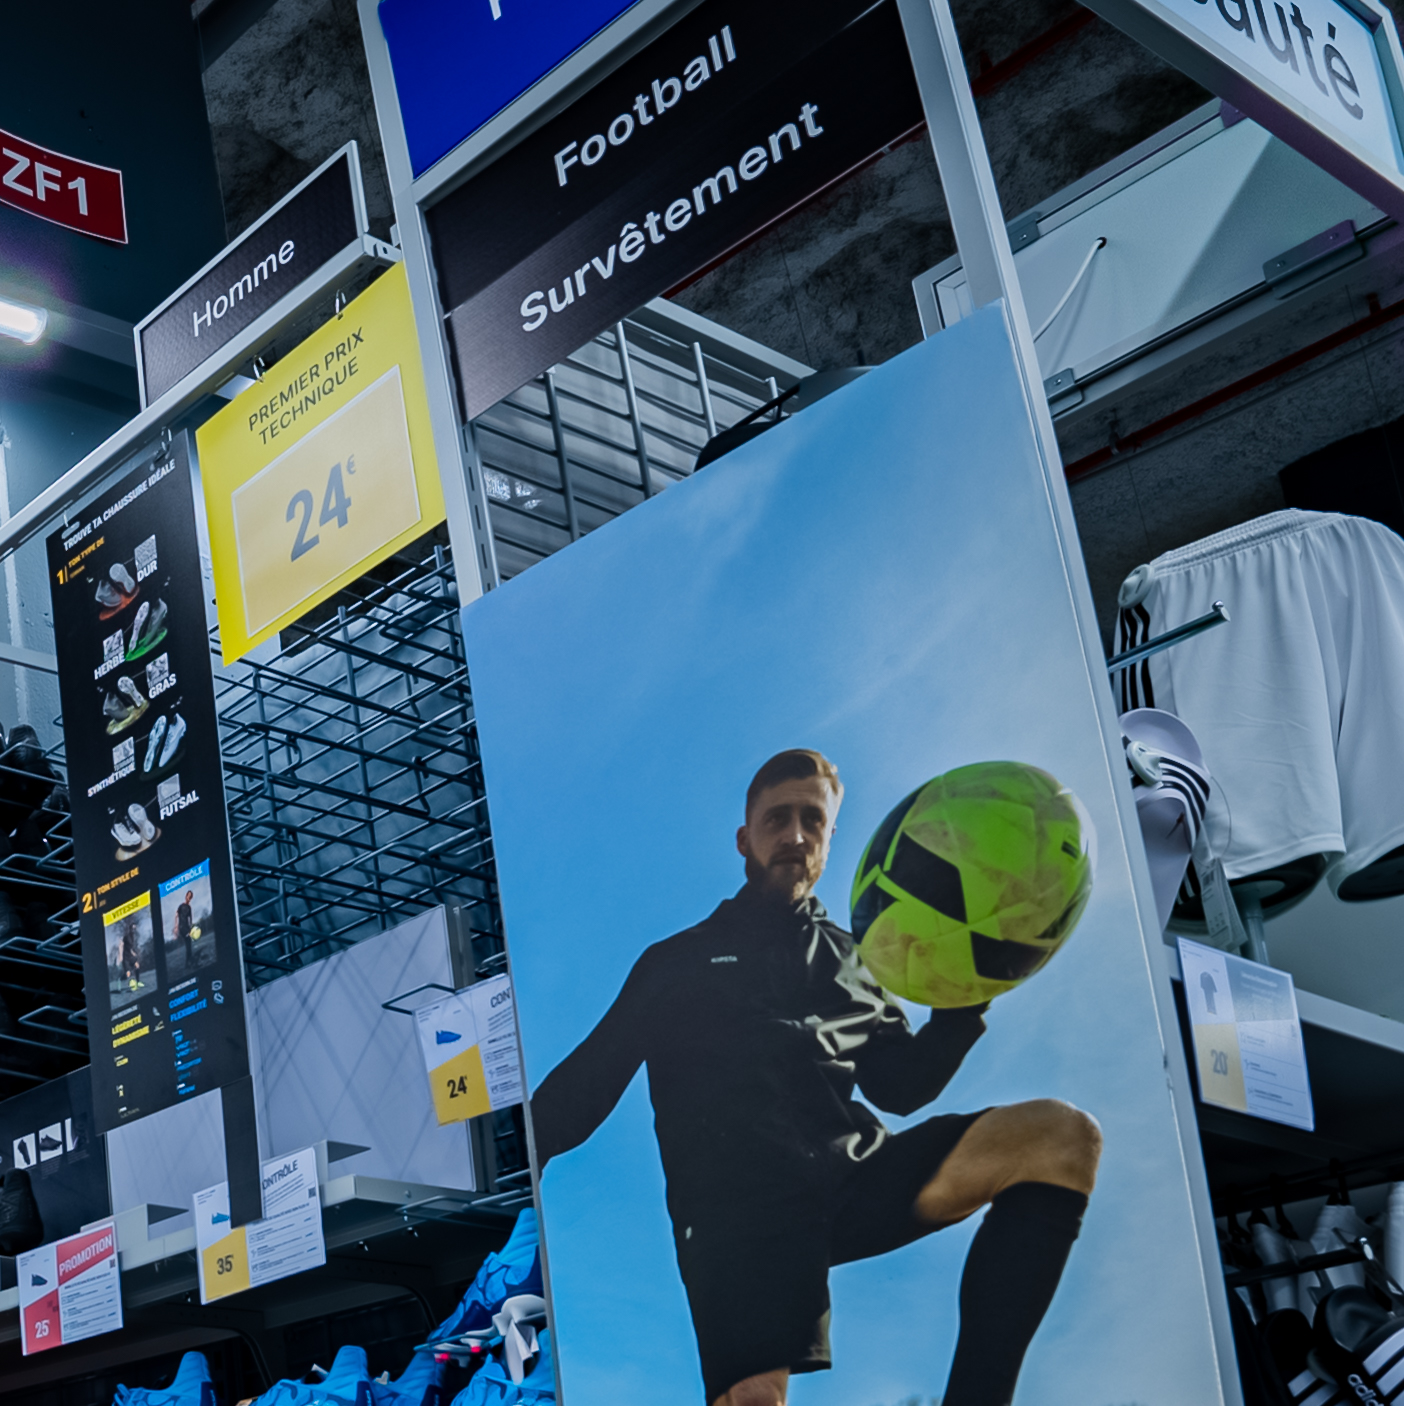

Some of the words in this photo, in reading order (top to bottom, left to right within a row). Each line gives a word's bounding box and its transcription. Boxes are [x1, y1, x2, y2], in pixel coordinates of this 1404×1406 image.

[1200, 0, 1363, 120] auté
[553, 24, 737, 187] Football
[2, 147, 88, 216] ZF1
[520, 100, 824, 335] Survêtement
[192, 239, 295, 337] Homme
[248, 360, 321, 431] PREMIER
[323, 327, 364, 377] PRIX
[258, 362, 359, 446] TECHNIQUE
[63, 523, 92, 551] TROUVE
[93, 516, 103, 529] TA
[103, 480, 148, 522] CHAUSSURE
[148, 458, 176, 488] IDÉALE
[137, 560, 158, 583] DUR
[94, 653, 125, 680] HERBE
[148, 673, 177, 699] GRAS
[160, 790, 199, 820] FUTSAL
[165, 866, 203, 891] CONTRÔLE
[82, 892, 93, 914] 2
[447, 1075, 468, 1099] 24
[262, 1159, 299, 1190] ONTRÔLE
[58, 1233, 113, 1277] PROMOTION
[217, 1254, 234, 1275] 35
[35, 1319, 51, 1339] 25
